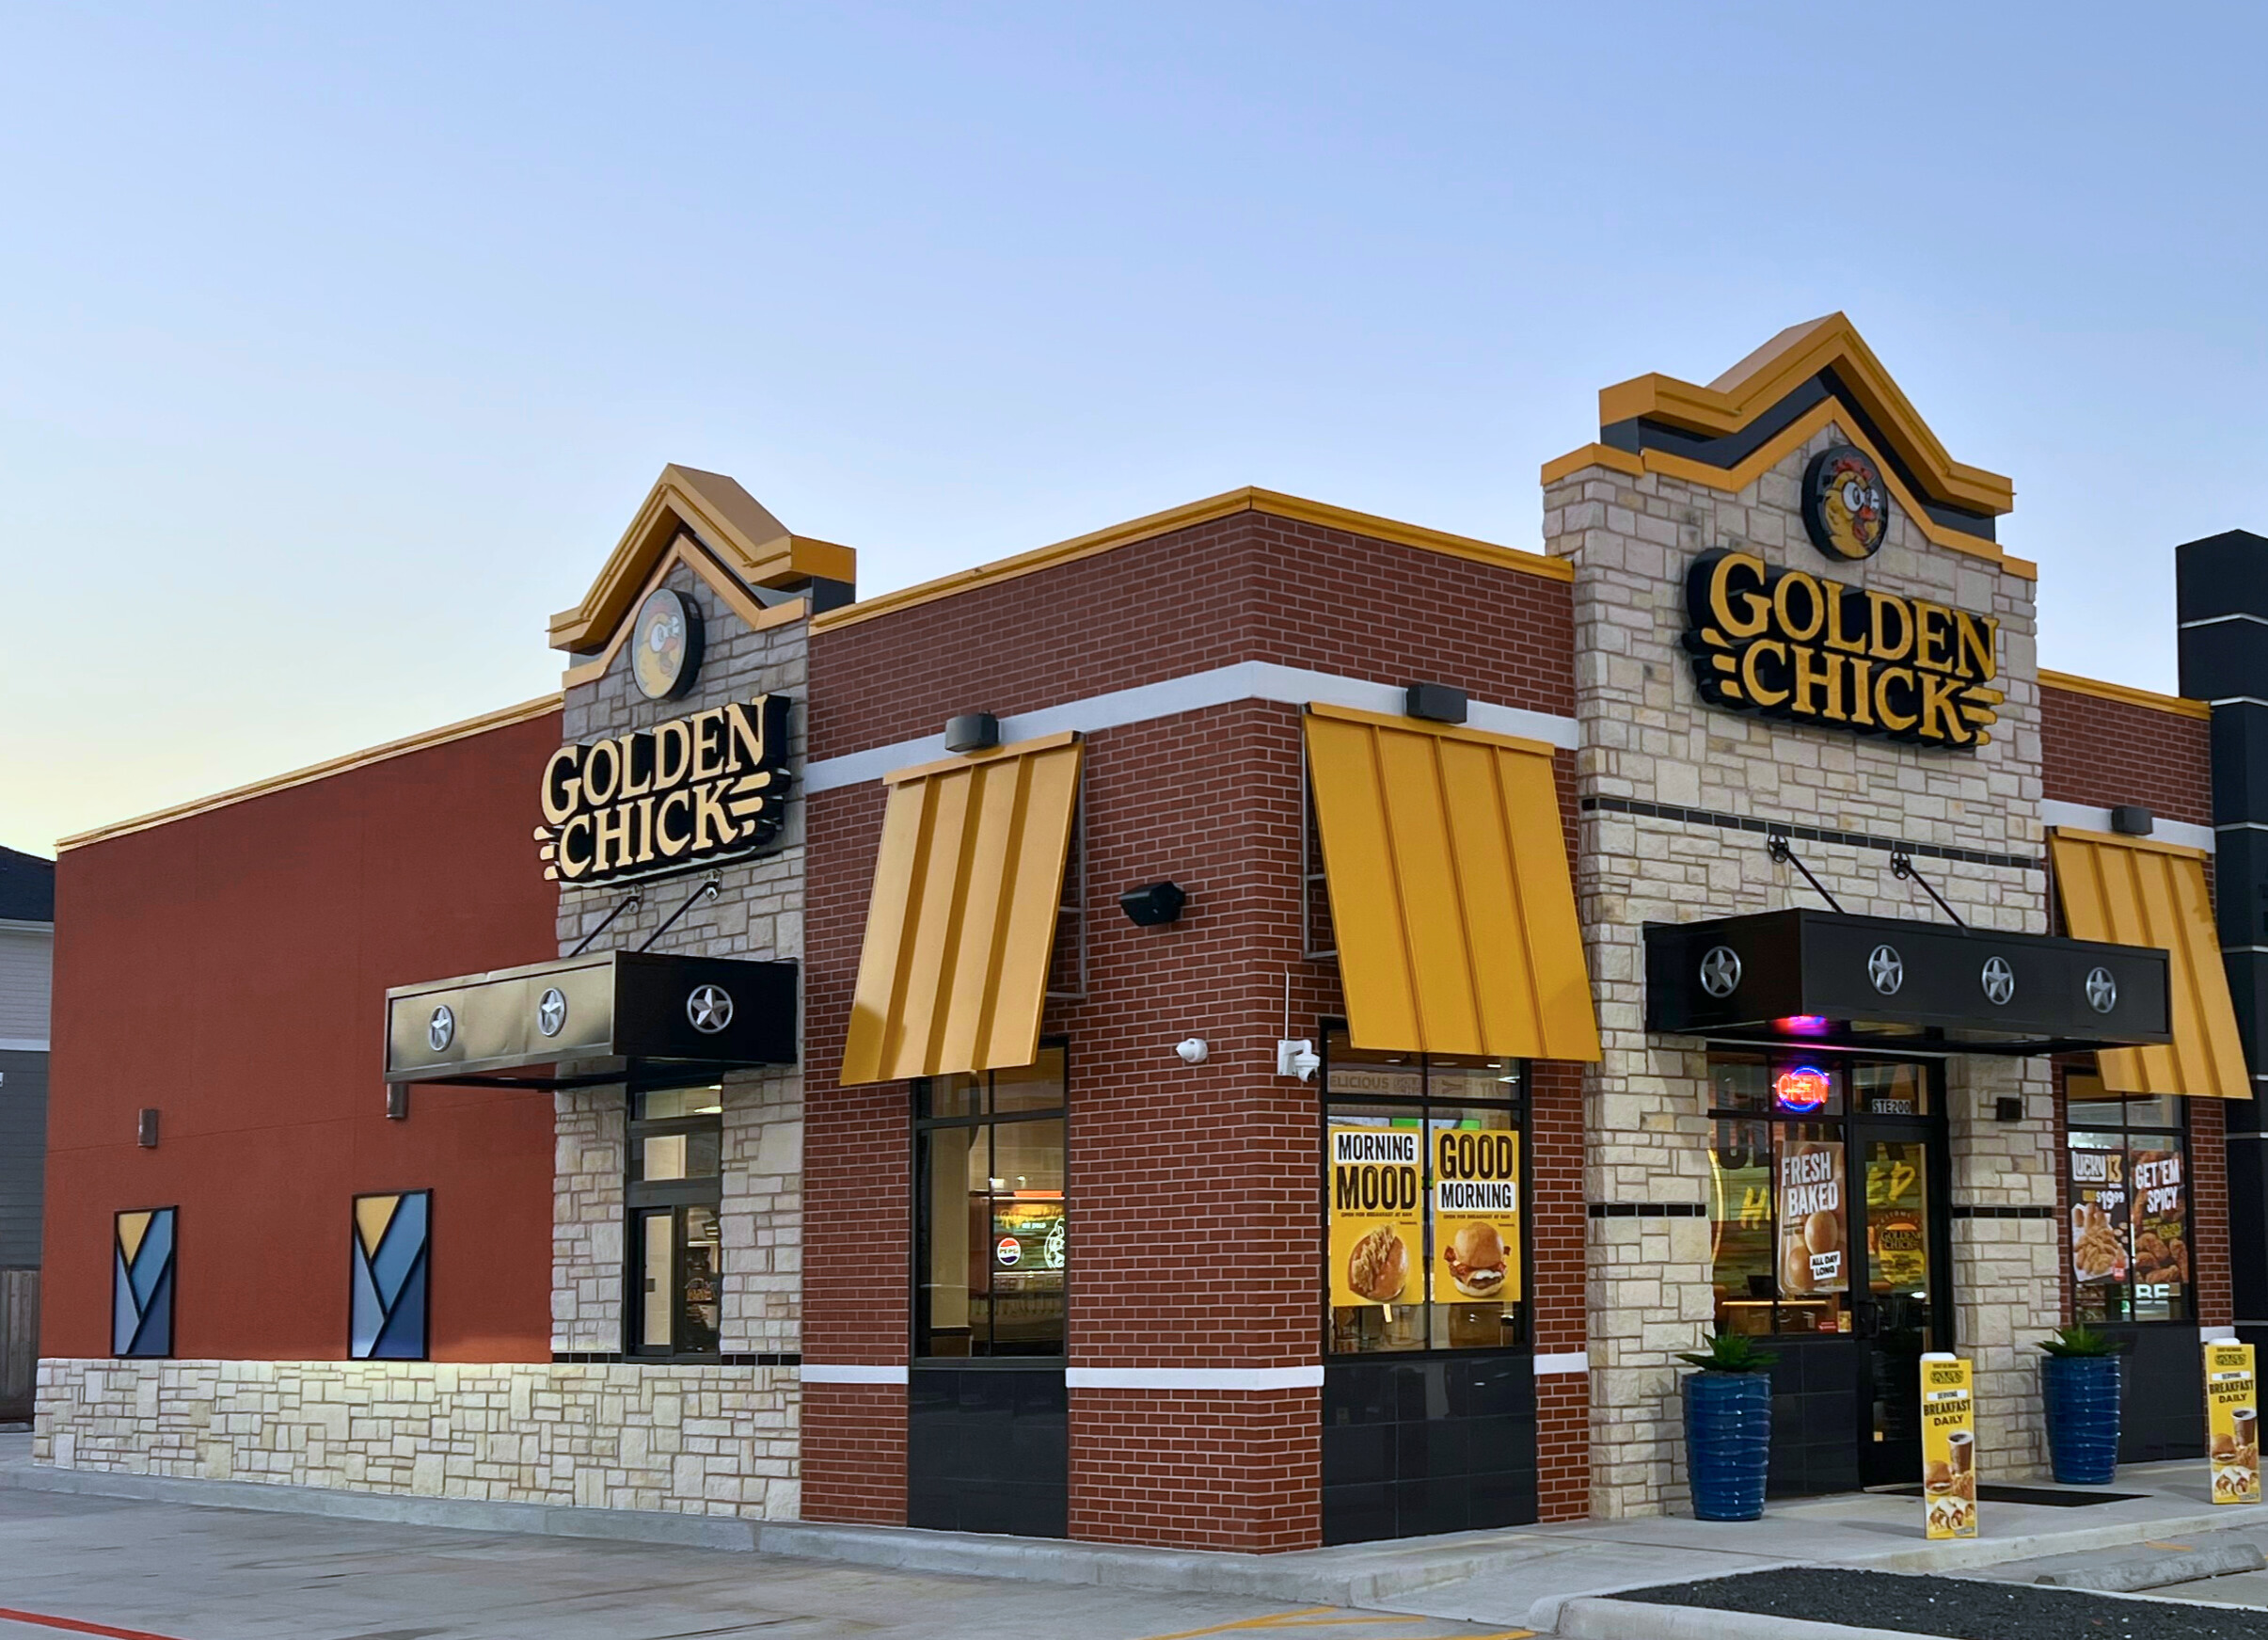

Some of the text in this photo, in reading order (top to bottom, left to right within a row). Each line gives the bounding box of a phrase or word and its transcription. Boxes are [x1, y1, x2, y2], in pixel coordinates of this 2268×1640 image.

[1710, 552, 2000, 681] GOLDEN
[1742, 639, 1972, 743] CHICK
[541, 694, 768, 825] GOLDEN
[560, 778, 738, 878] CHICK
[1330, 1075, 1389, 1090] ELICIOUS
[1338, 1135, 1414, 1160] MORNING
[1439, 1134, 1514, 1179] GOOD
[1782, 1151, 1832, 1186] FRESH
[2107, 1154, 2122, 1182] 13
[2135, 1161, 2158, 1189] GET
[1337, 1165, 1417, 1210] MOOD
[1441, 1183, 1511, 1208] MORNING
[1788, 1182, 1838, 1217] BAKED
[2147, 1186, 2178, 1213] SPICY
[1812, 1254, 1838, 1266] ALL DAY
[1816, 1266, 1834, 1276] LONG
[2209, 1380, 2253, 1394] BREAKFAST
[2218, 1393, 2246, 1403] DAILY
[1924, 1399, 1971, 1416] BREAKFAST
[1934, 1414, 1963, 1426] DAILY
